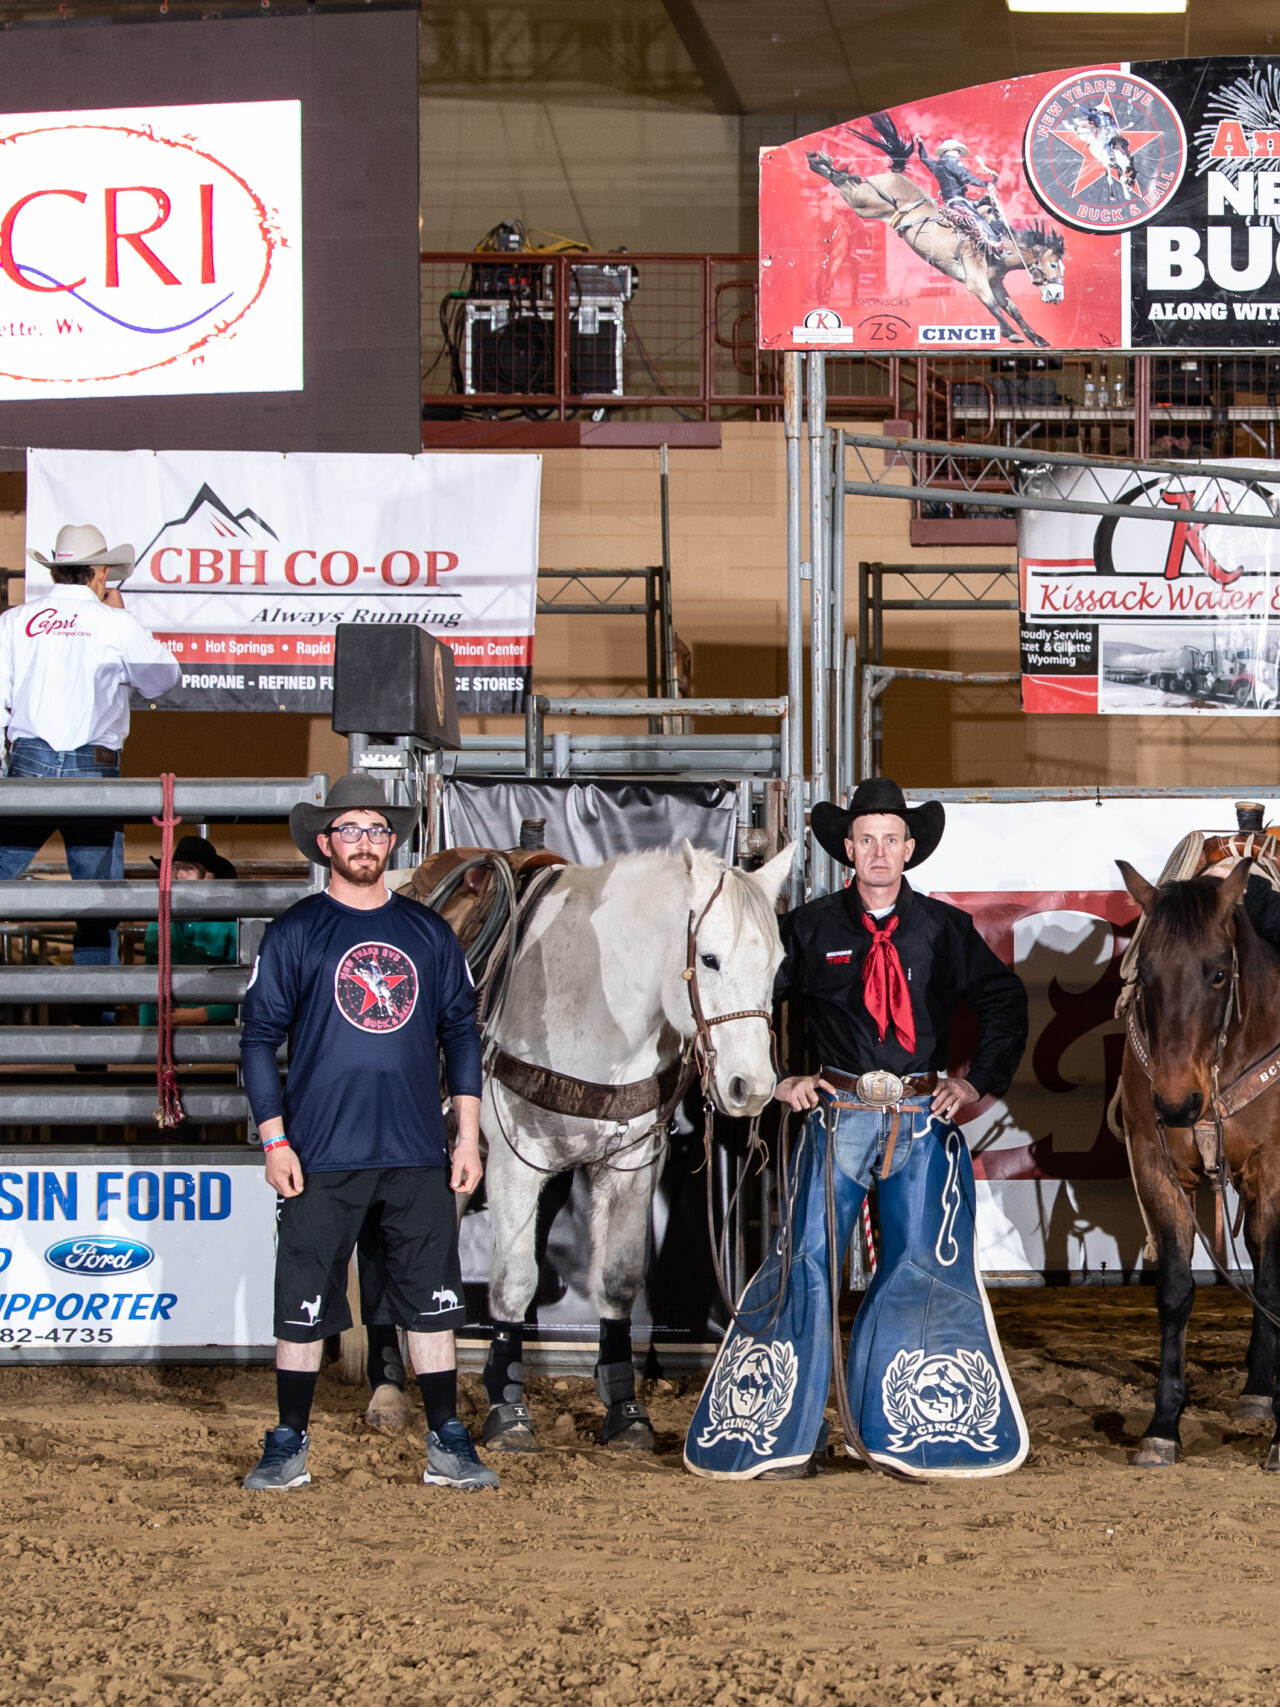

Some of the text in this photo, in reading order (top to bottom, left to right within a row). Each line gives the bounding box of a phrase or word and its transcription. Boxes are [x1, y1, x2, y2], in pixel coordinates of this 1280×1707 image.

[1037, 80, 1154, 137] NEW YEARS EVE
[1077, 171, 1175, 221] BUCK & BALL
[0, 184, 216, 293] CRI
[1148, 303, 1228, 320] ALONG
[870, 322, 898, 341] ZS
[922, 328, 996, 341] CINCH
[149, 548, 459, 588] CBH CO-OP
[1040, 579, 1164, 613] Kissack
[1168, 583, 1266, 611] Water
[25, 608, 79, 638] Capri
[251, 608, 464, 628] Always Running
[1053, 629, 1093, 643] Serving
[205, 641, 226, 653] Hot
[228, 640, 275, 656] Springs
[296, 642, 331, 656] Rapid
[450, 643, 526, 656] Union Center
[1043, 642, 1053, 653] &
[1053, 641, 1092, 653] Gillette
[1027, 653, 1077, 668] Wyoming
[181, 674, 245, 690] PROPANE
[258, 676, 317, 690] REFINED
[472, 676, 525, 691] STORES
[96, 1171, 232, 1222] FORD
[65, 1241, 135, 1270] Ford
[722, 1419, 756, 1434] CINCH
[915, 1422, 967, 1434] CINCH
